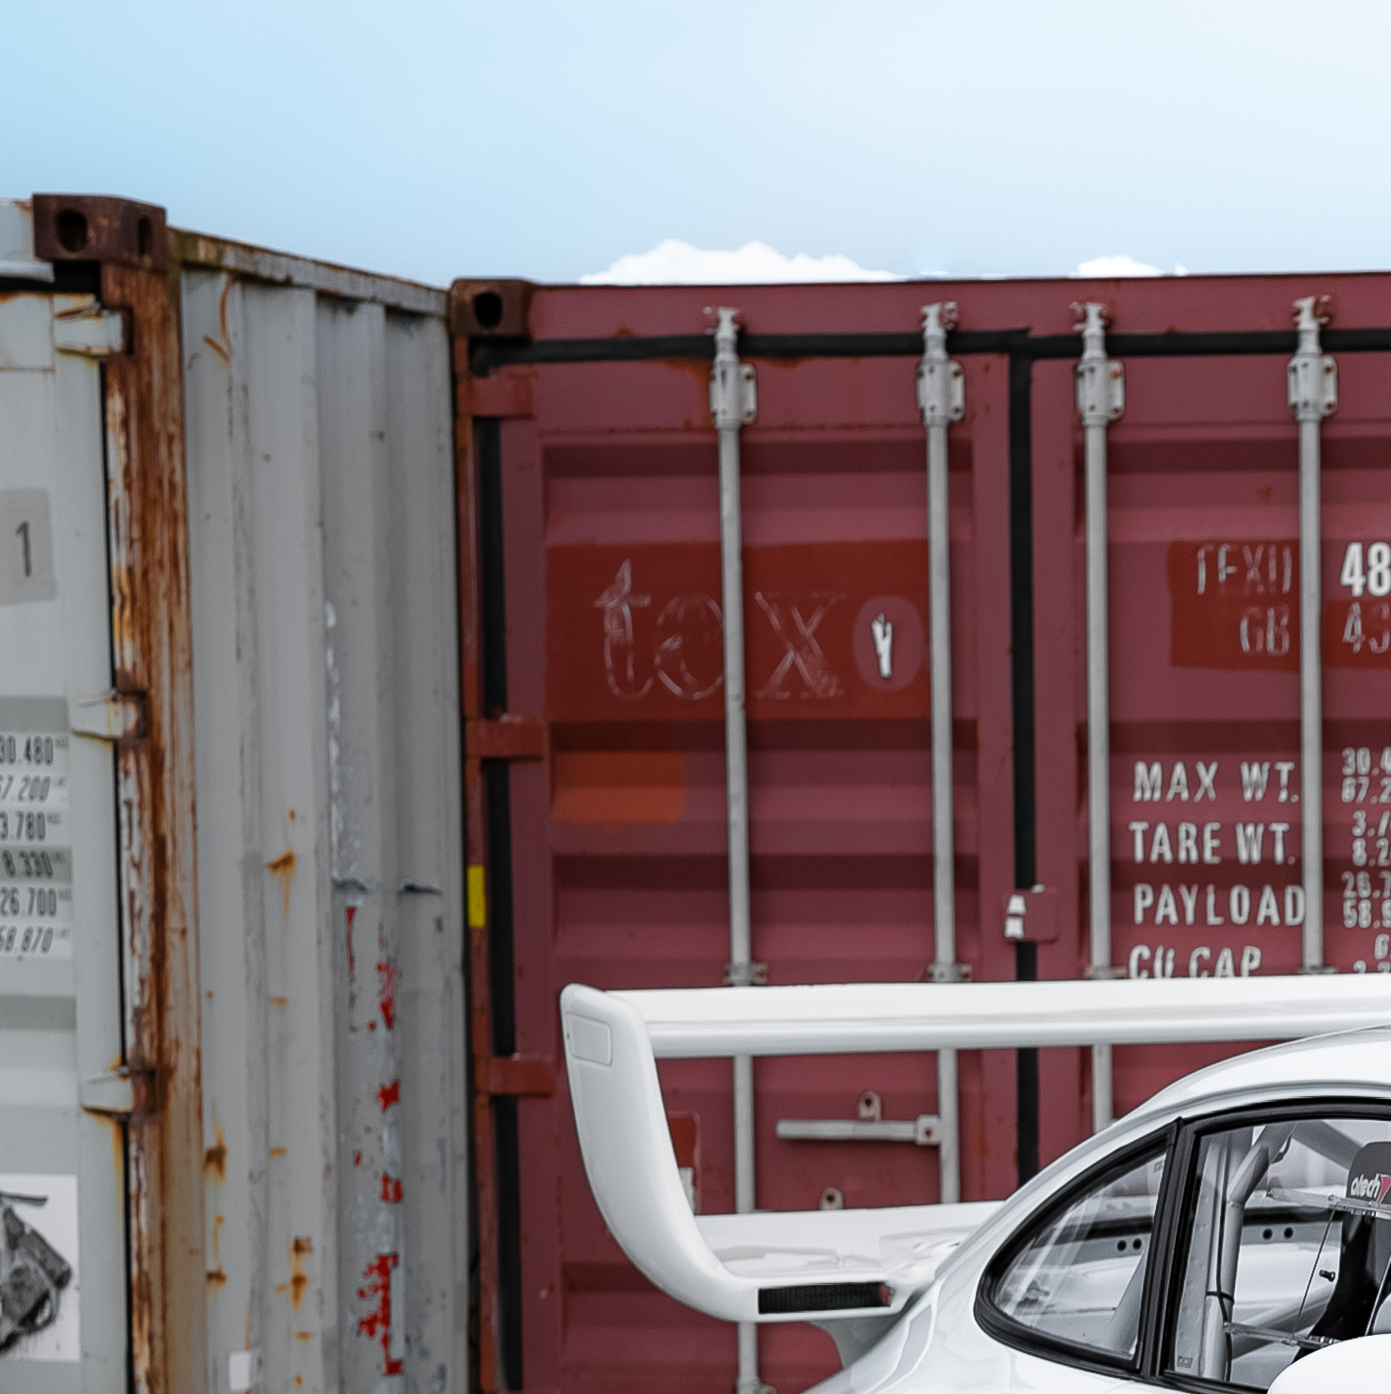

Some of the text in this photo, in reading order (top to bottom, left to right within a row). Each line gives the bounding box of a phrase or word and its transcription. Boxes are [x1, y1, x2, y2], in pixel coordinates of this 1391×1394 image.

[15, 521, 31, 578] 1
[0, 774, 51, 802] 7.200
[1133, 760, 1299, 803] MAX WT.
[1129, 821, 1295, 865] TARE WT.
[1133, 884, 1305, 926] PAYLOAD
